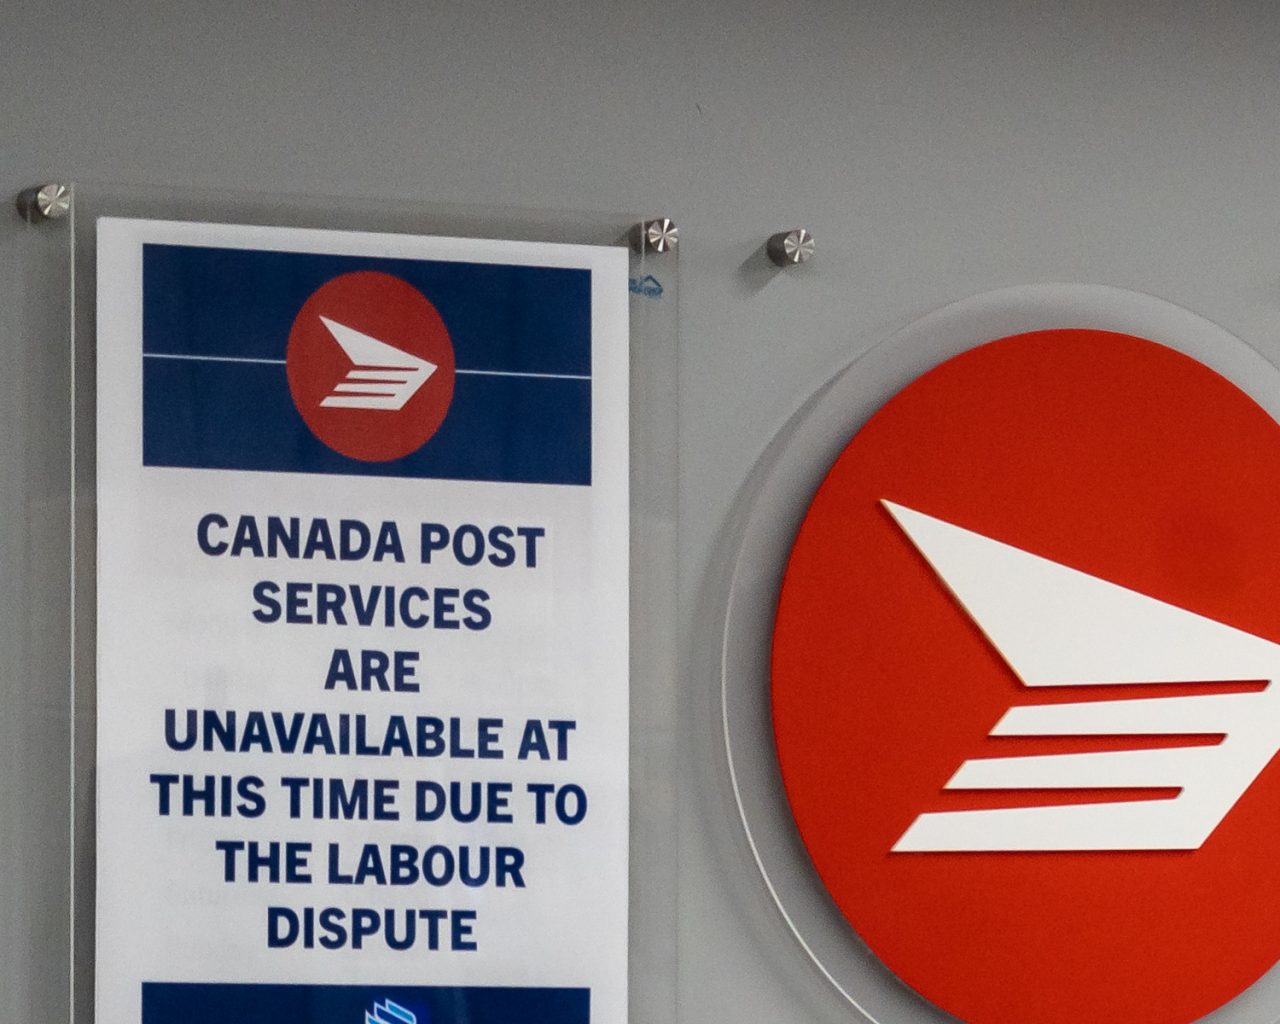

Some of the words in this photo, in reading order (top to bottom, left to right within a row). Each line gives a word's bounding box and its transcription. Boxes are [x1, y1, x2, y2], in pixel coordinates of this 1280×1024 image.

[197, 514, 405, 563] CANADA
[421, 523, 545, 568] POST
[253, 581, 491, 630] SERVICES
[324, 649, 419, 692] ARE
[165, 709, 503, 759] UNAVAILABLE
[518, 720, 576, 760] AT
[150, 774, 266, 818] THIS
[281, 777, 399, 821] TIME
[416, 781, 513, 823] DUE
[527, 783, 587, 825] TO
[216, 841, 312, 883] THE
[329, 843, 525, 887] LABOUR
[268, 907, 477, 951] DISPUTE
